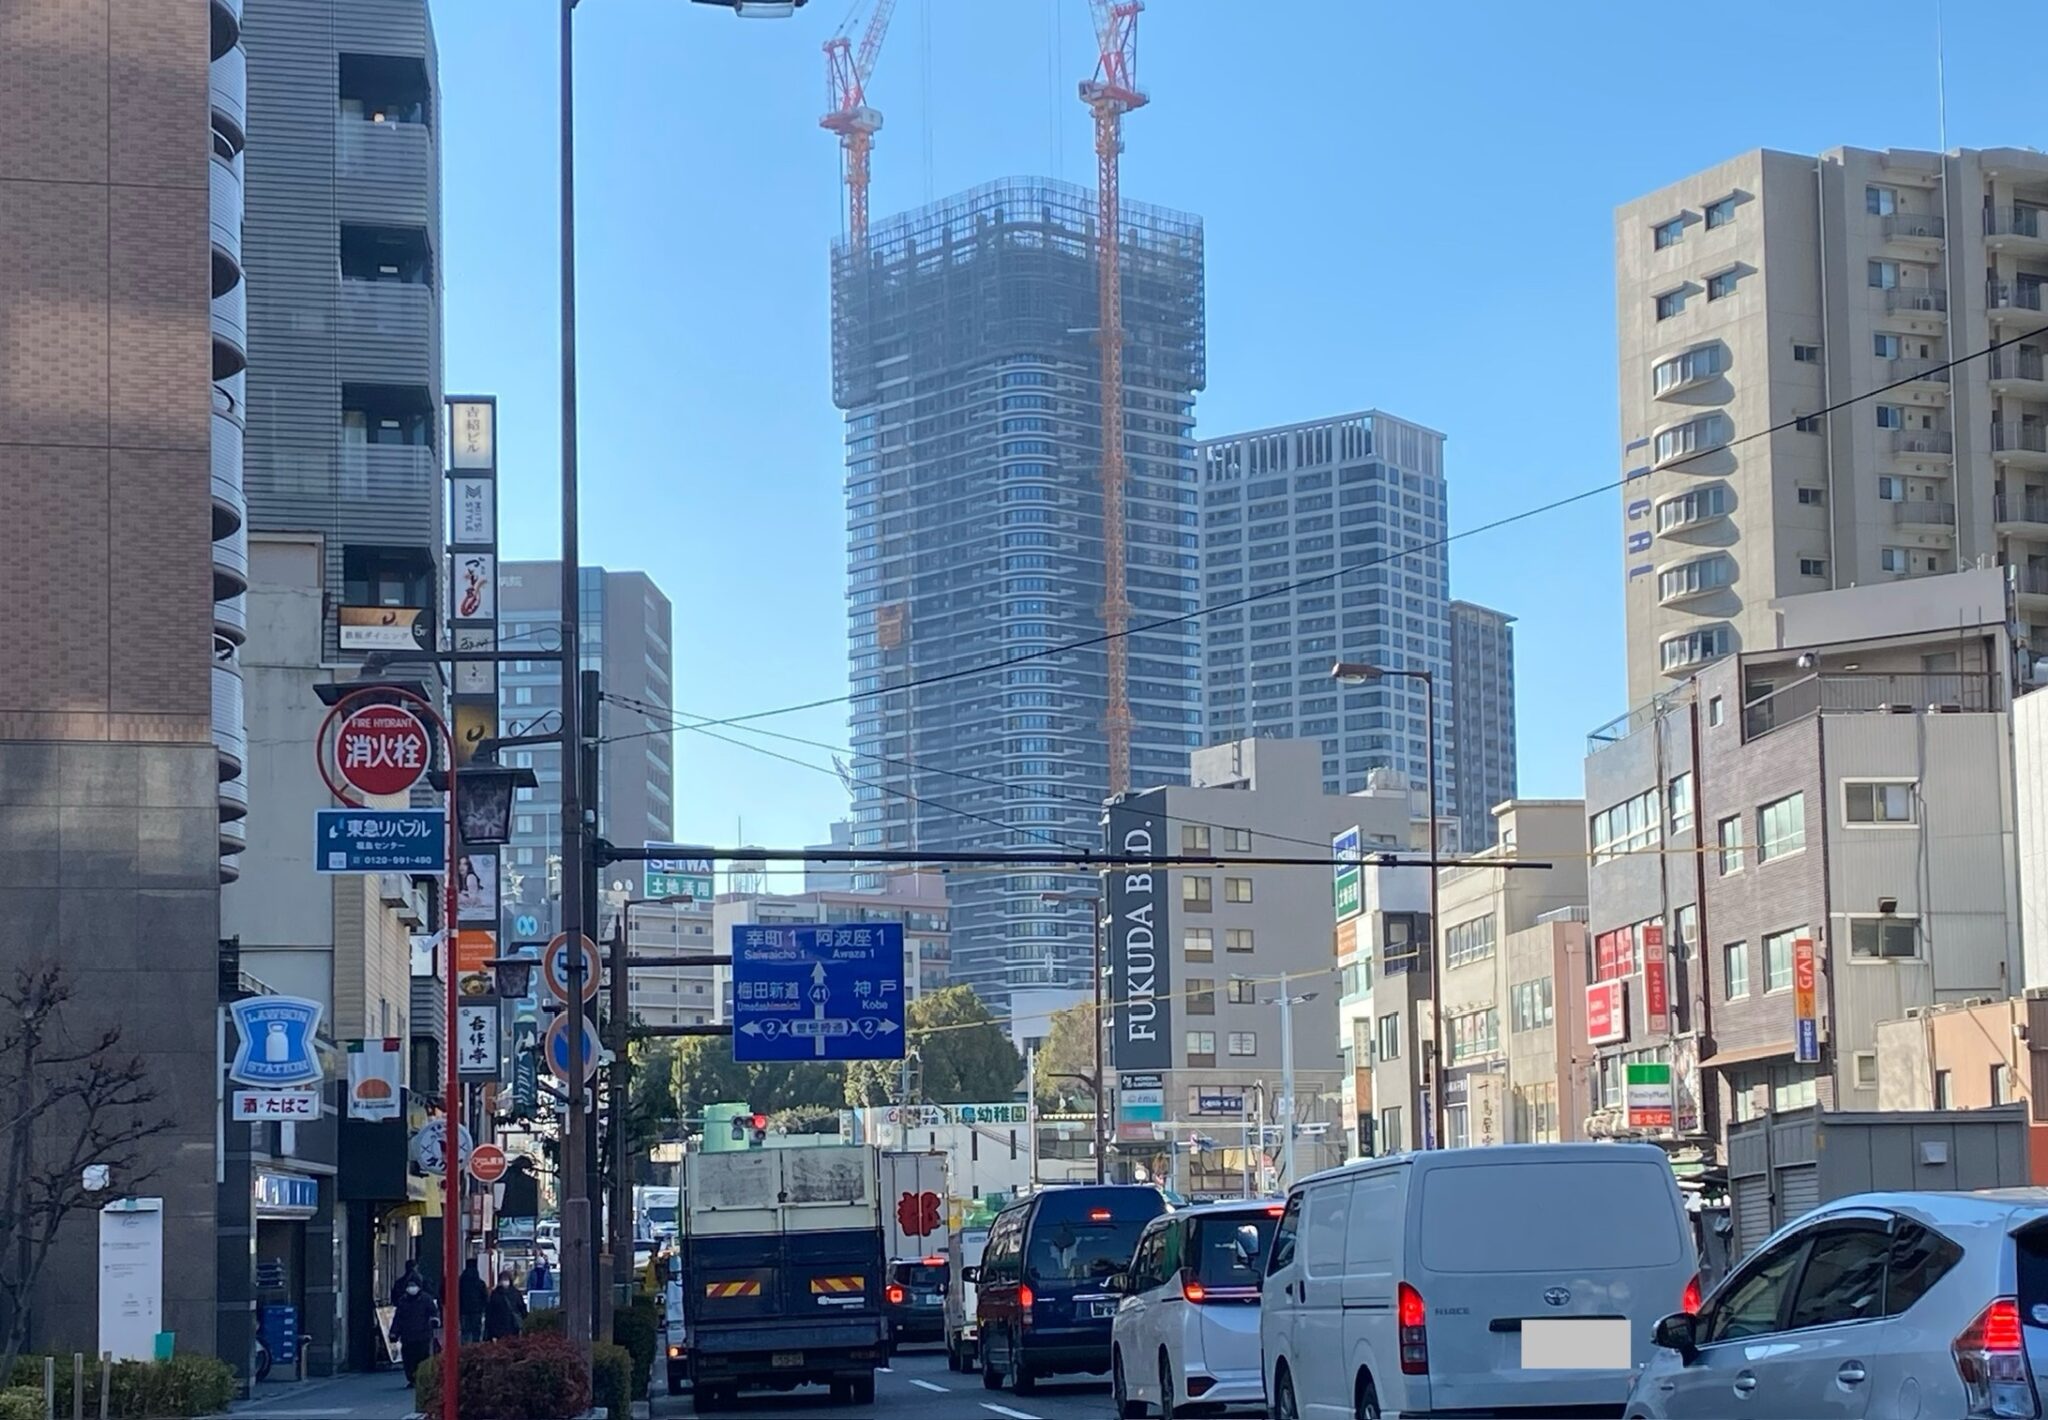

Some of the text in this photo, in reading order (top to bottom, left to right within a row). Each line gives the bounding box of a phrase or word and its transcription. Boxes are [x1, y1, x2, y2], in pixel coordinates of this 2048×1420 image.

[352, 718, 413, 728] FIRE HYDRANT
[345, 733, 422, 769] 消火栓
[346, 819, 432, 838] 東急リバブル
[745, 949, 806, 960] Saiwaicho 1
[869, 949, 875, 959] 1
[1125, 902, 1156, 1042] FUKUDA
[737, 981, 800, 1000] 梅田新道
[812, 988, 827, 1000] 41
[853, 979, 898, 998] 神戸
[862, 1000, 888, 1010] Kobe
[247, 1008, 307, 1023] LAWSON
[766, 1022, 776, 1034] 2
[865, 1021, 873, 1033] 2
[248, 1060, 309, 1074] STATION
